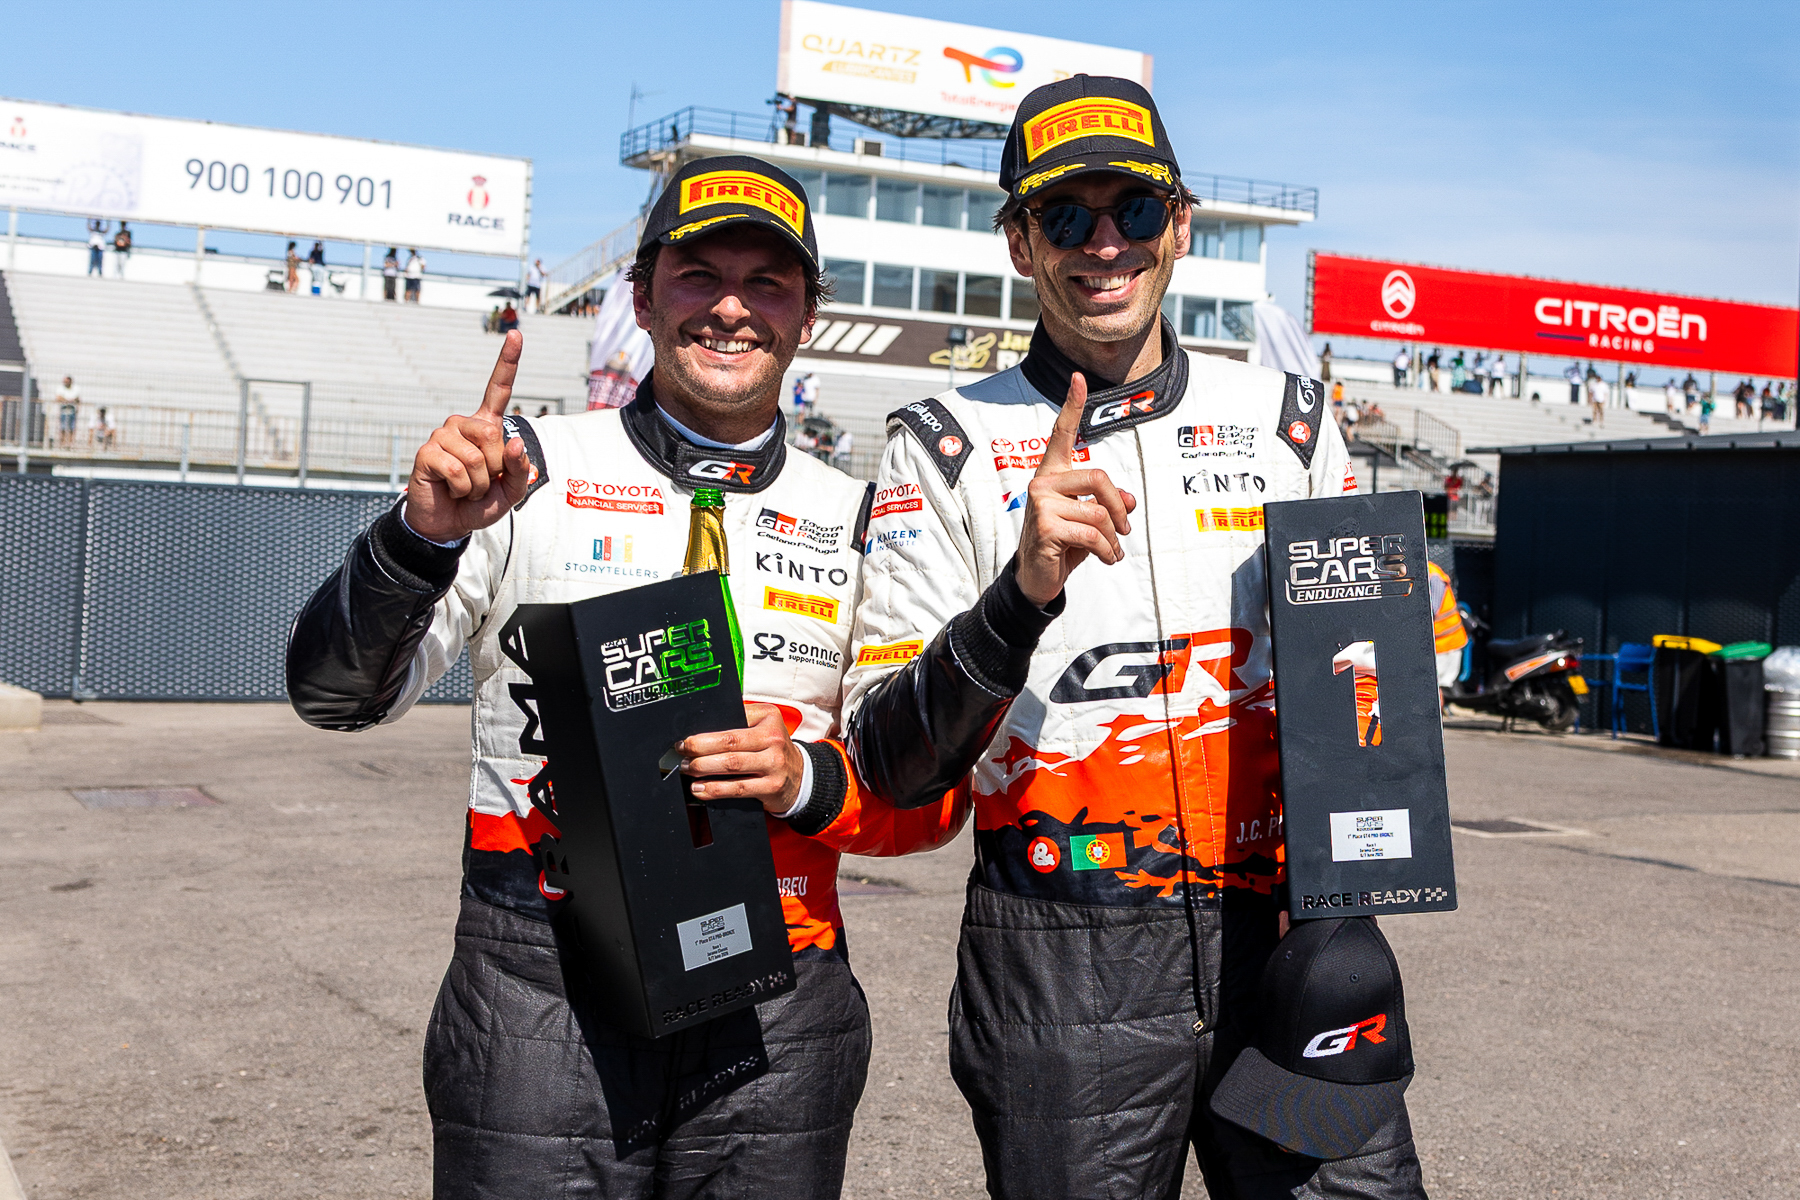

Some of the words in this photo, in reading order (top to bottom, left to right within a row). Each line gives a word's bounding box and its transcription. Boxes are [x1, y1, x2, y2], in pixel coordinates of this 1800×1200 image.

[802, 33, 921, 66] QUARTZ
[1031, 104, 1145, 151] PIRELLI
[185, 158, 249, 194] 900
[263, 167, 323, 201] 100
[335, 174, 392, 210] 901
[689, 176, 798, 224] PIRELLI
[447, 212, 505, 231] RACE
[1588, 333, 1655, 354] RACING
[1089, 390, 1155, 427] GR
[688, 459, 756, 484] GR
[592, 482, 662, 499] TOYOTA
[876, 483, 922, 503] TOYOTA
[616, 502, 659, 512] SERVICES
[886, 501, 918, 511] SERVICES
[757, 515, 795, 535] GR
[801, 519, 843, 532] TOYOTA
[1200, 510, 1263, 528] PIRELLI
[797, 531, 837, 546] Racing
[1288, 534, 1408, 561] SUPER
[565, 562, 659, 579] STORYTELLERS
[1289, 554, 1408, 586] CARS
[1296, 584, 1382, 601] ENDURANCE
[769, 591, 834, 618] PIRELLI
[601, 618, 710, 664] SUPER
[789, 654, 815, 665] support
[858, 644, 919, 662] PIRELLI
[605, 641, 715, 692] CARS
[1049, 627, 1254, 704] GR
[615, 677, 696, 709] ENDURANCE
[1301, 892, 1353, 910] RACE
[1357, 888, 1422, 906] READY
[661, 999, 709, 1026] RACE
[712, 976, 767, 1008] READY
[1302, 1013, 1387, 1058] GR
